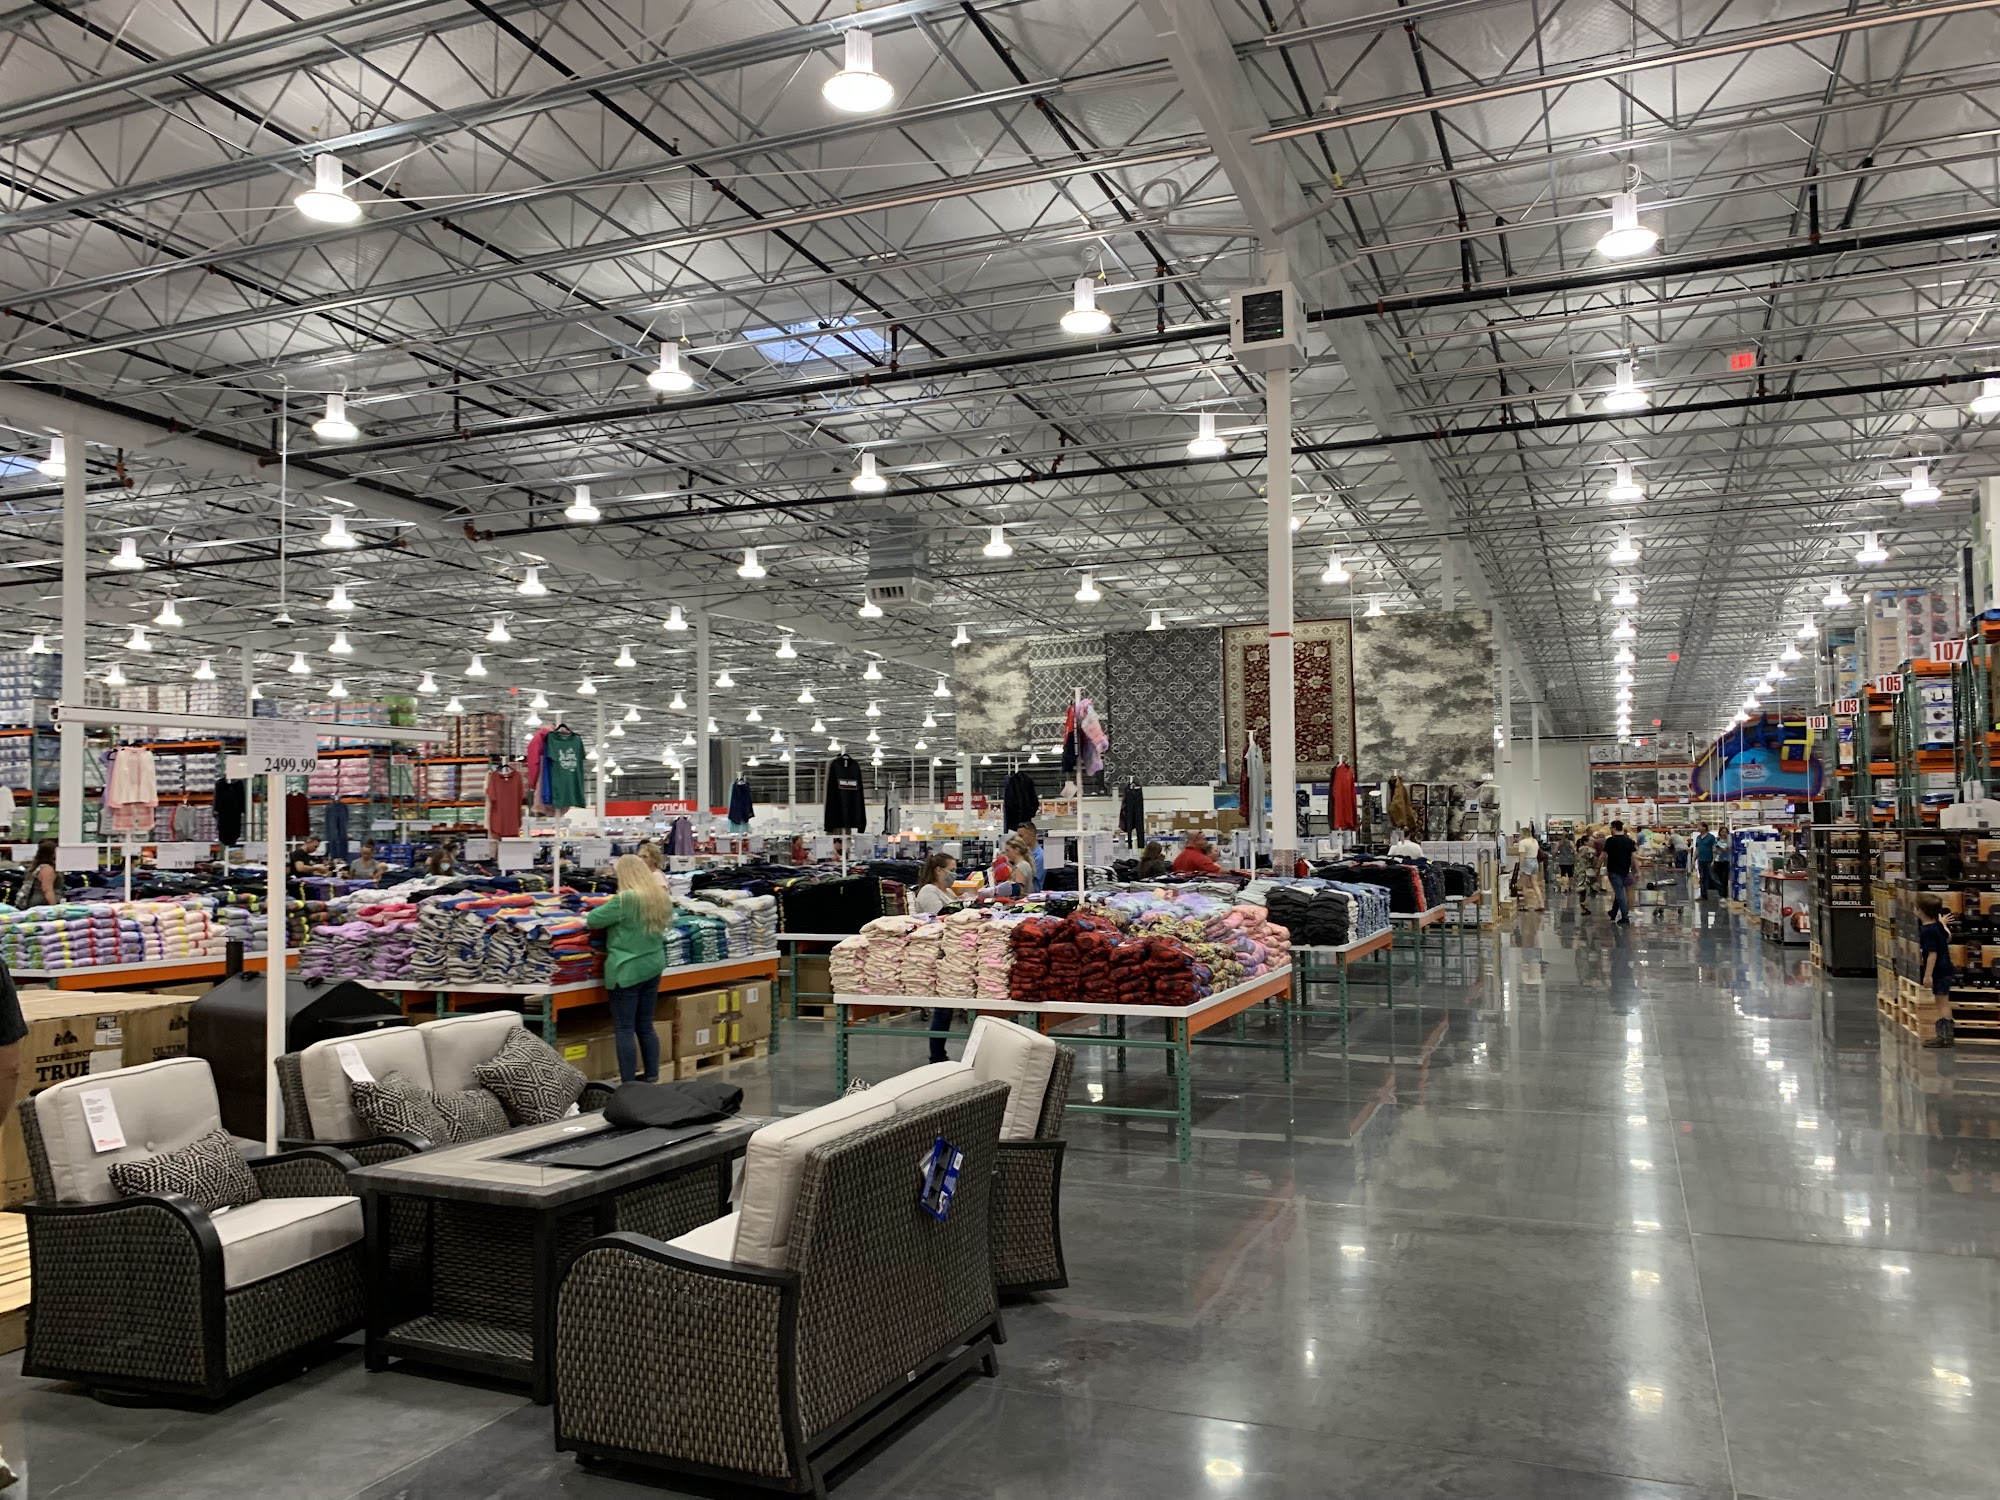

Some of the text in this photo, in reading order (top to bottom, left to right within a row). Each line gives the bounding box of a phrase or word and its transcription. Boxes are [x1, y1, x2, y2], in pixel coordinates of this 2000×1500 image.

[1731, 352, 1755, 371] EXIT
[1934, 642, 1964, 661] 107
[1879, 676, 1901, 692] 105
[1837, 700, 1857, 713] 103
[1808, 717, 1825, 728] 101
[264, 757, 316, 773] 2499.99
[652, 803, 687, 812] OPTICAL
